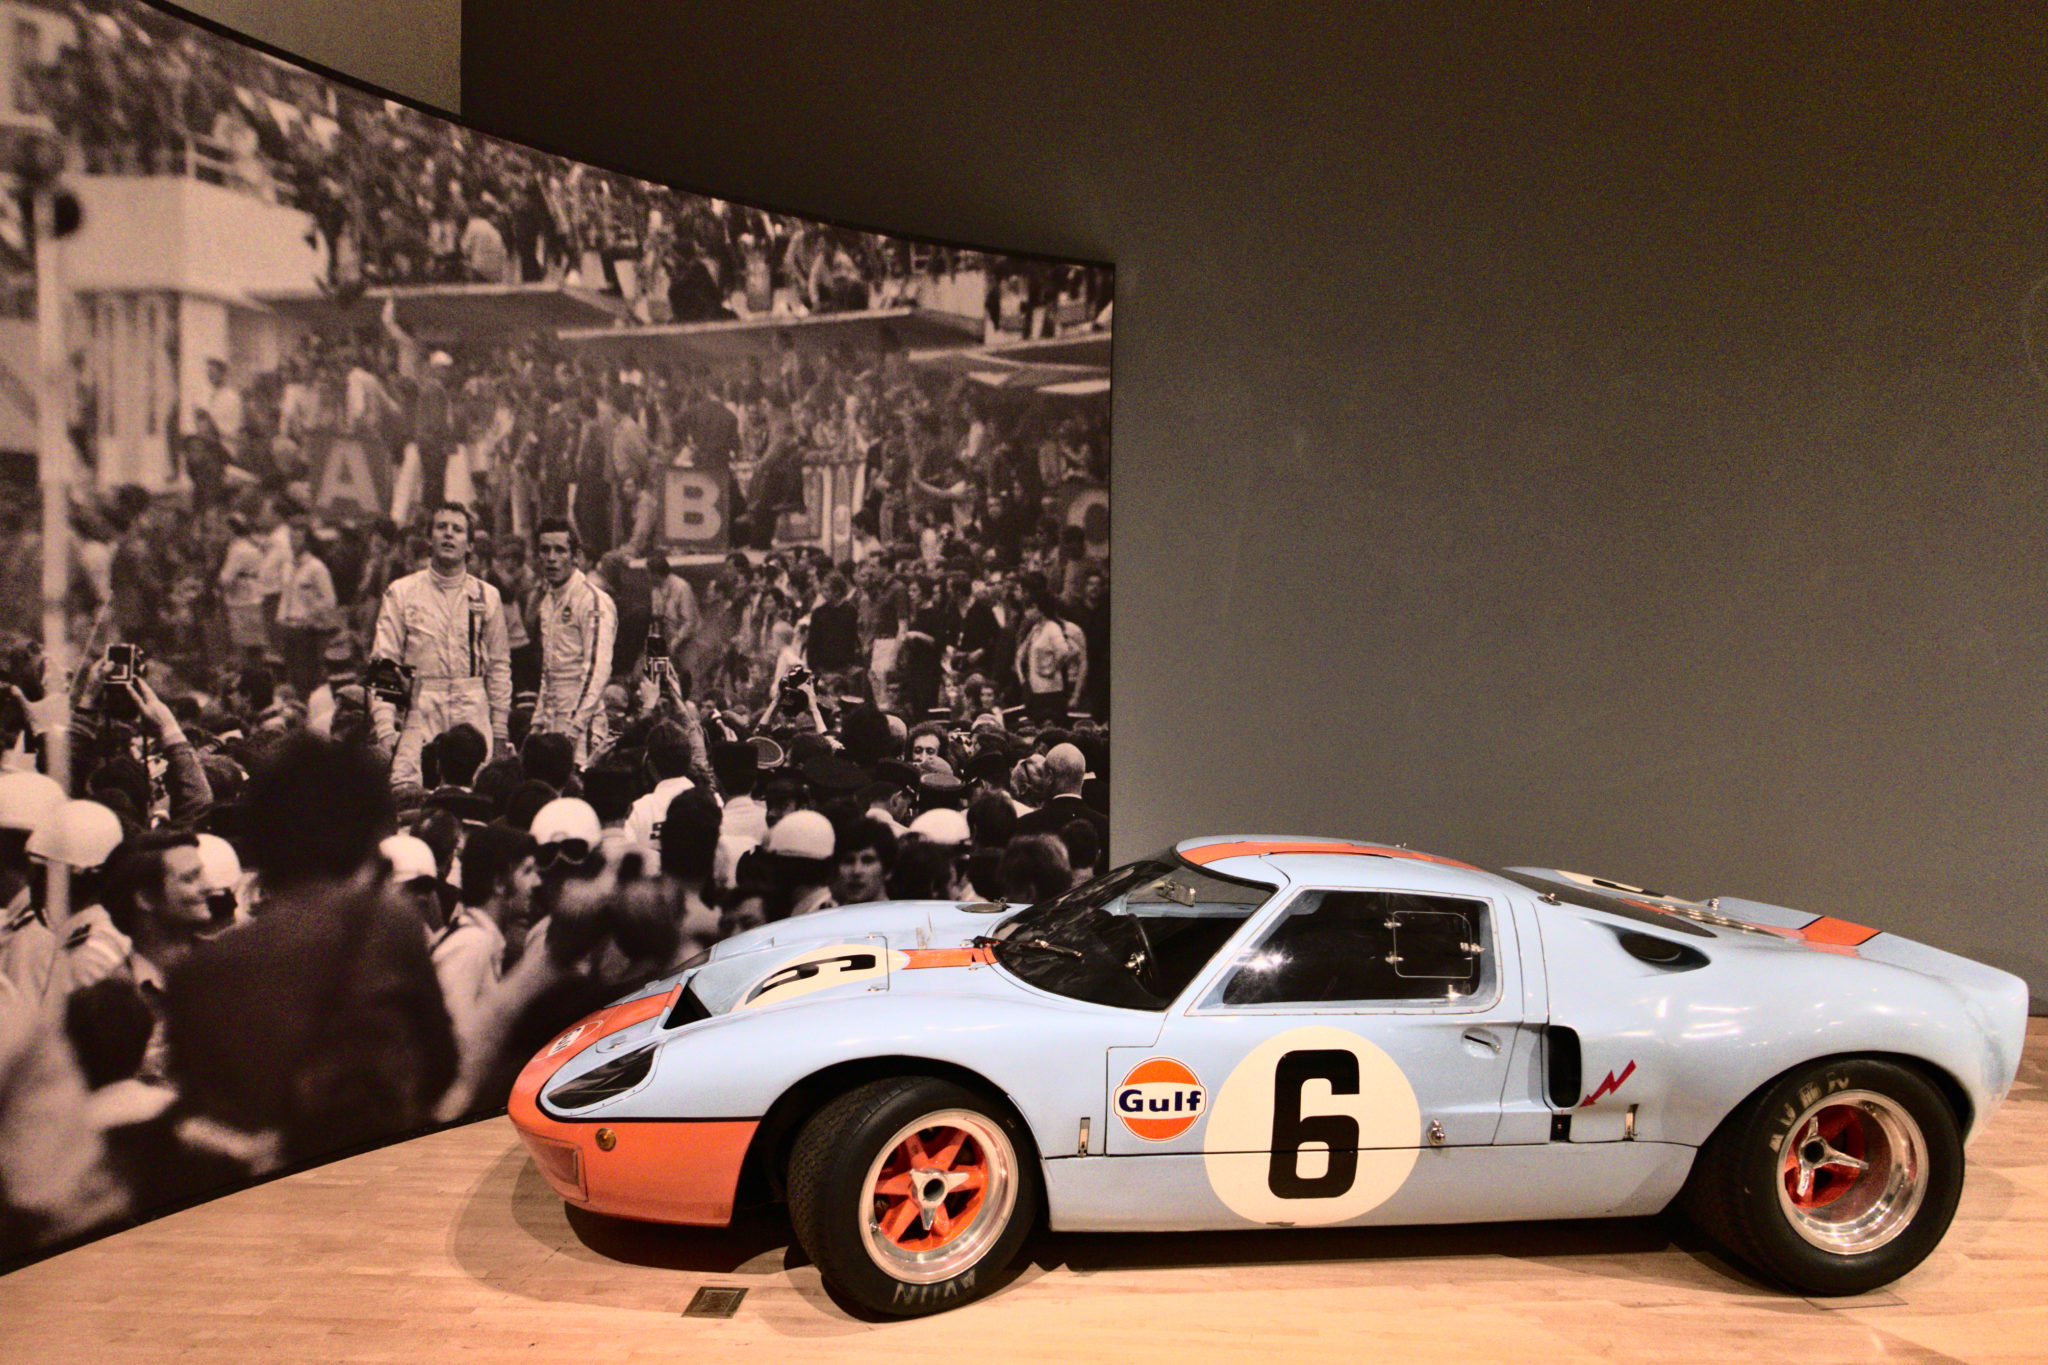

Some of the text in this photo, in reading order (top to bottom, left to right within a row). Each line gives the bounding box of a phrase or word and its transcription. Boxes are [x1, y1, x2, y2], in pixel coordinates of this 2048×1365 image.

[665, 472, 721, 540] B
[1118, 1088, 1202, 1113] Gulf
[1268, 1049, 1360, 1199] 6
